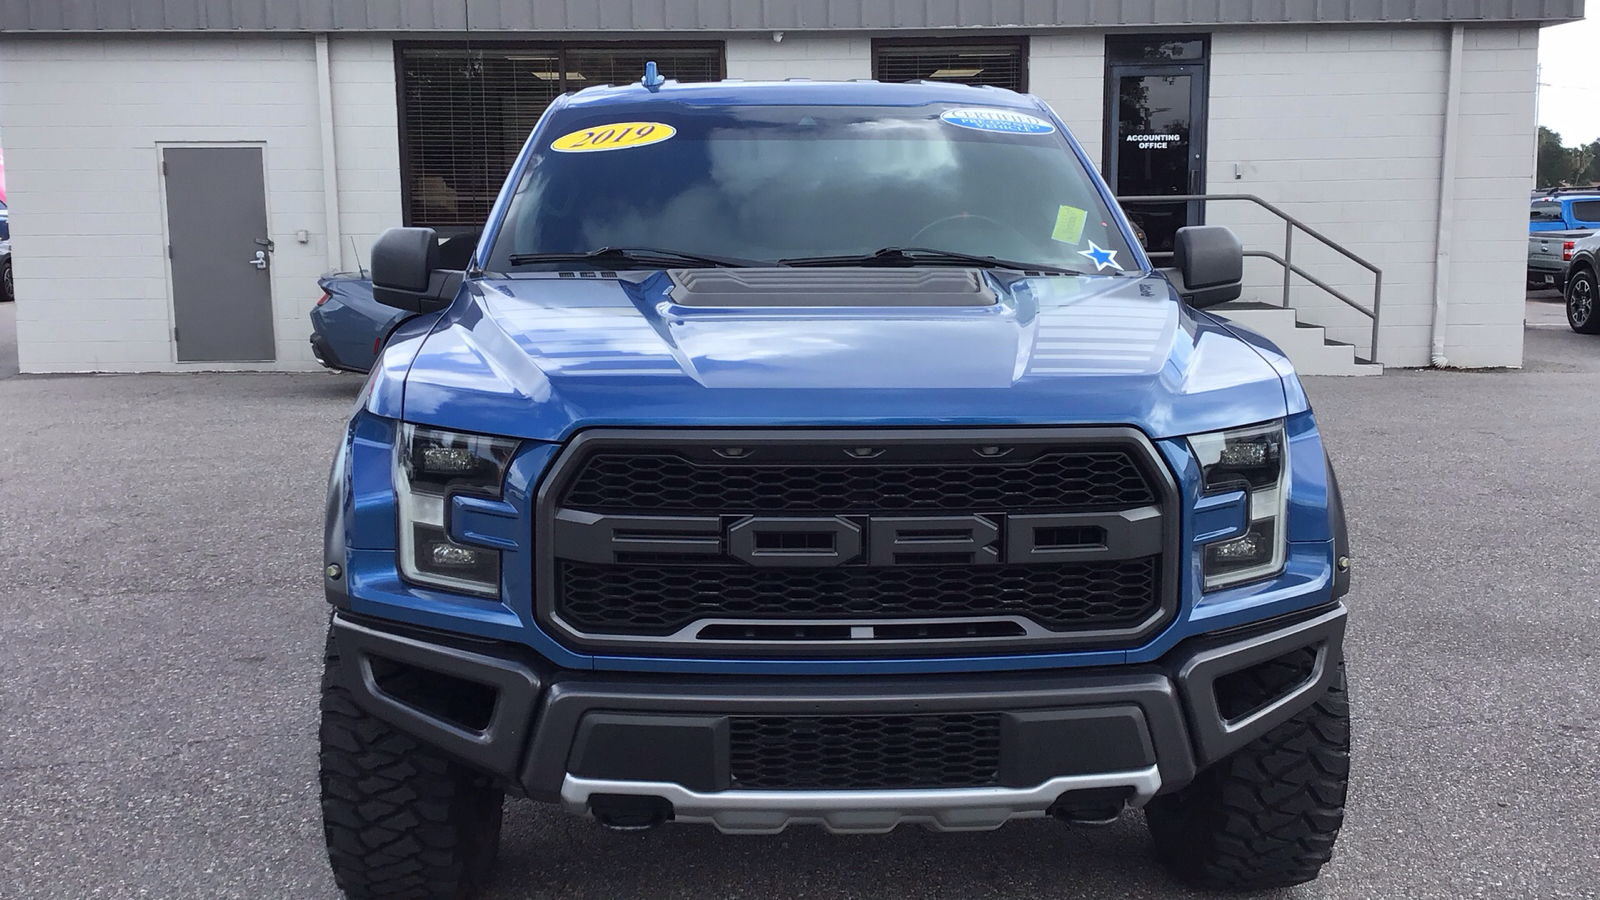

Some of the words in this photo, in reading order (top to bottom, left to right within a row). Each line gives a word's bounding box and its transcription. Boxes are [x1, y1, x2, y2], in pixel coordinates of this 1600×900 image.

[951, 110, 1040, 126] CERTIFIED
[568, 125, 655, 149] 2019
[1126, 134, 1181, 142] ACCOUNTING
[560, 512, 1160, 566] FORD
